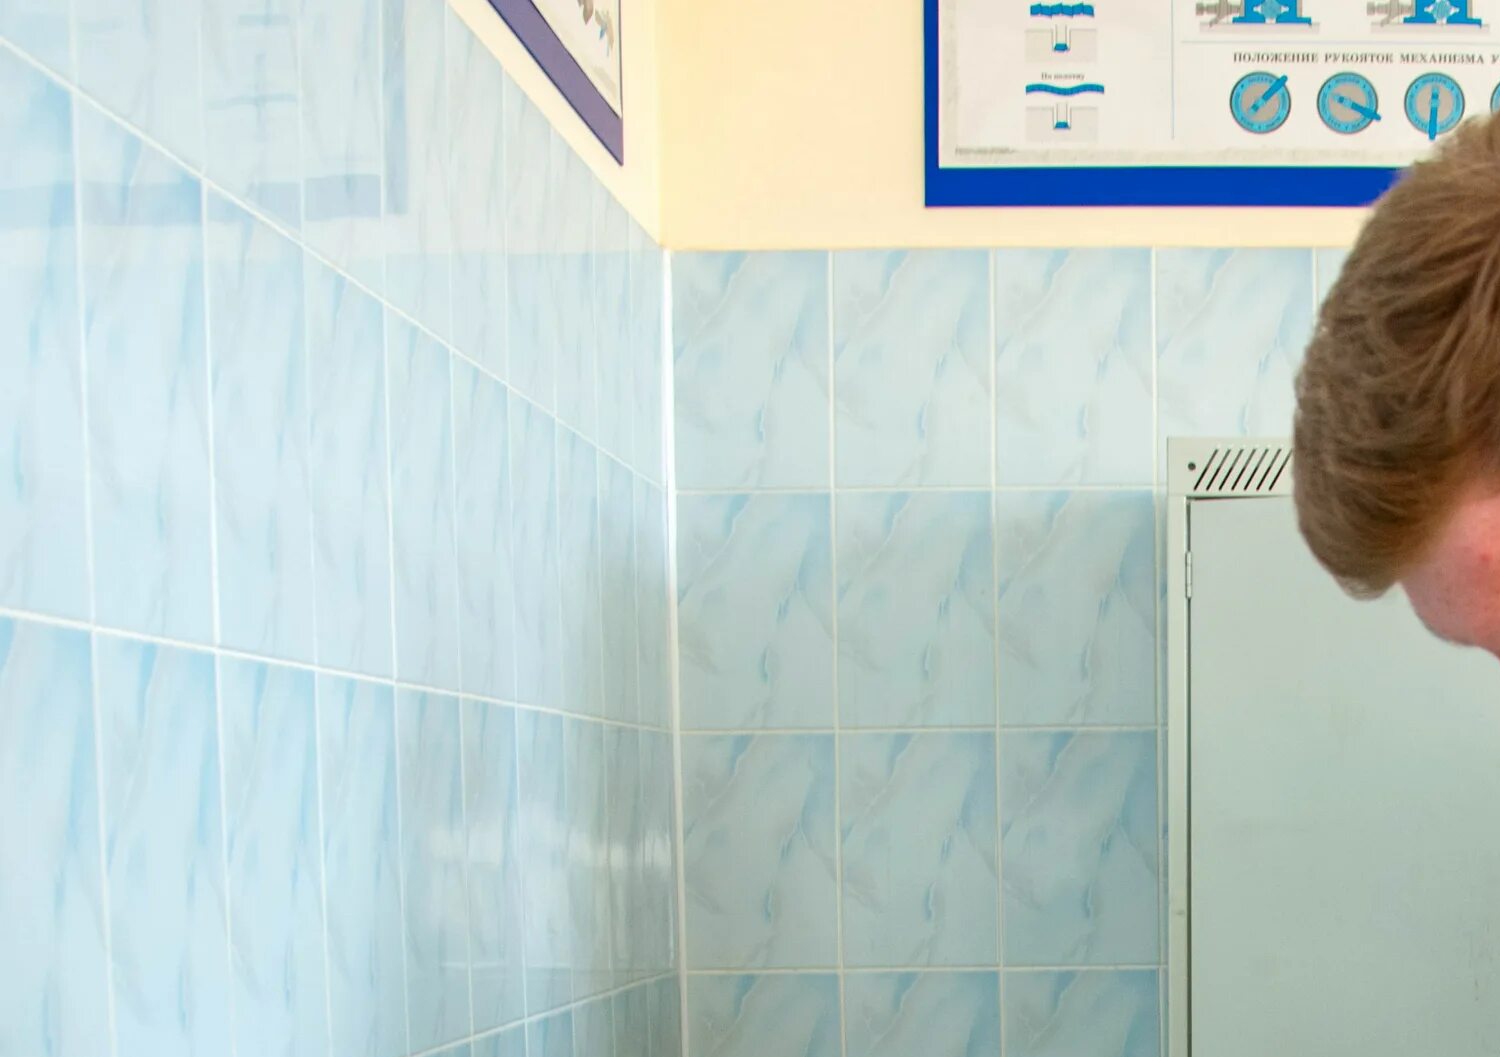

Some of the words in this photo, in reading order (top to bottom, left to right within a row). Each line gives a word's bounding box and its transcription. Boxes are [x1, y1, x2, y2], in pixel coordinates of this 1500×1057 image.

[1233, 52, 1319, 63] ПОЛОЖЕНИЕ
[1324, 53, 1393, 64] РУКОЯТОК
[1400, 53, 1485, 65] МЕХАНИЗМА
